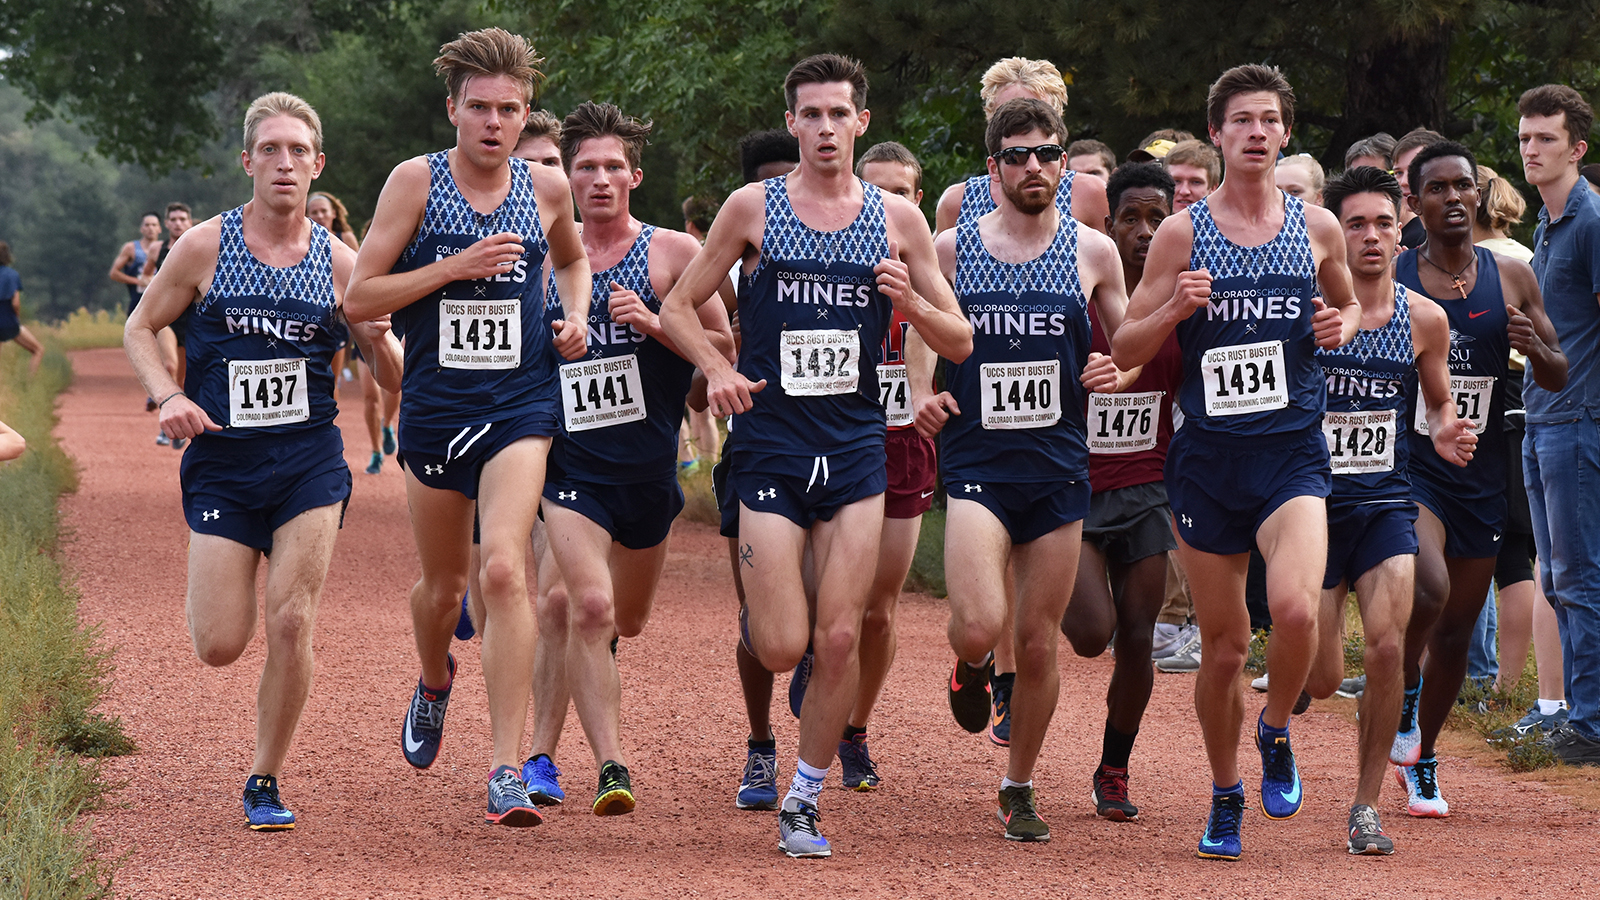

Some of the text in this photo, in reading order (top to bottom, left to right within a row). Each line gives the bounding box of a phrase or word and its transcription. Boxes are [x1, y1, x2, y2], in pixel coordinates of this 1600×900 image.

[777, 280, 871, 308] MINES
[445, 304, 515, 316] UCCS RUST BUSTER
[1206, 296, 1301, 321] MINES
[226, 316, 319, 342] MINES
[450, 319, 511, 350] 1431
[969, 313, 1066, 336] MINES
[444, 353, 470, 362] COLORADO
[791, 347, 850, 378] 1432
[1207, 345, 1278, 363] UCCS RUST BUSTER
[1447, 348, 1470, 362] SU
[234, 362, 301, 375] UCCS RUST BUSTER
[565, 359, 633, 379] UCCS RUST BUSTER
[885, 369, 908, 379] BUSTE
[986, 365, 1055, 378] UCCS RUST BUSTER
[1214, 360, 1276, 397] 1434
[240, 375, 298, 409] 1437
[571, 374, 633, 413] 1441
[1463, 380, 1489, 390] BUSTER
[880, 381, 907, 411] 74
[991, 379, 1051, 412] 1440
[1094, 395, 1157, 406] UCCS RUST BUSTER
[1212, 402, 1238, 410] COLORADO
[1451, 392, 1481, 420] 51
[236, 412, 261, 421] COLORADO
[571, 416, 596, 426] COLORADO
[987, 416, 1013, 424] COLORADO
[1097, 408, 1151, 437] 1476
[1328, 415, 1347, 424] UCCS
[1349, 415, 1367, 425] RUST
[1331, 426, 1387, 457] 1428
